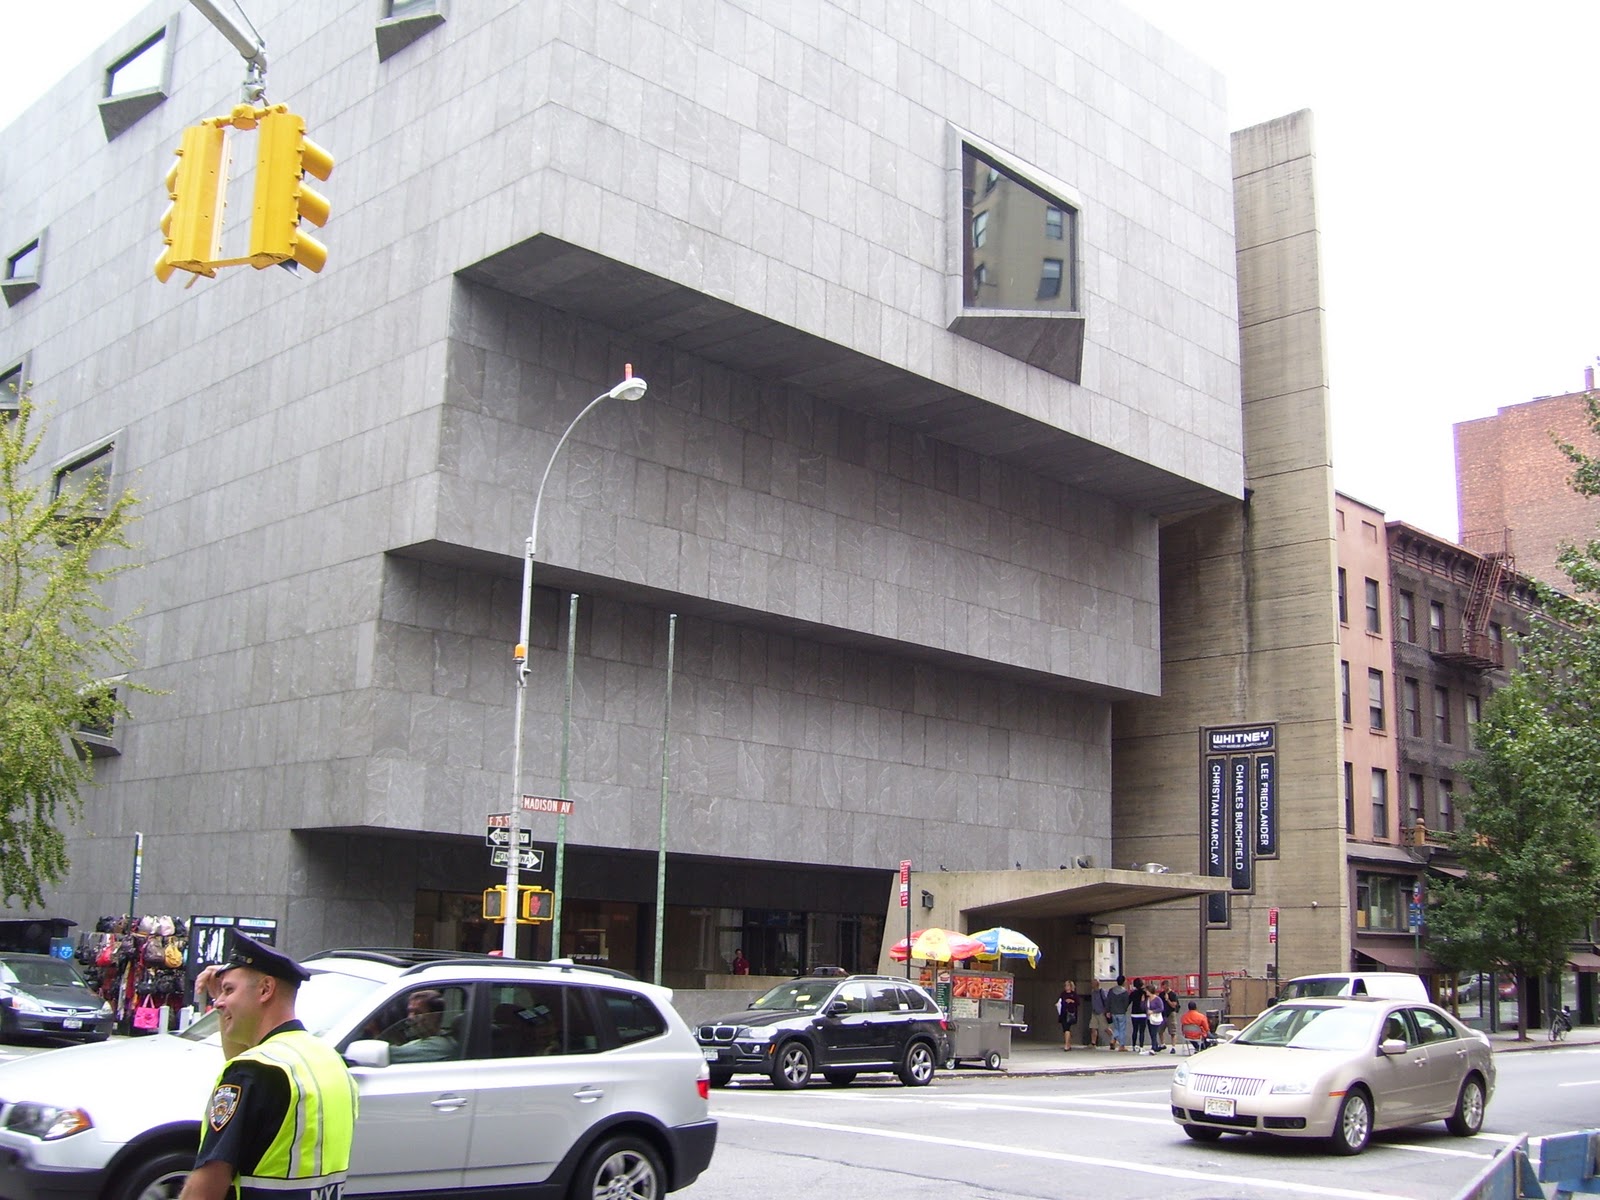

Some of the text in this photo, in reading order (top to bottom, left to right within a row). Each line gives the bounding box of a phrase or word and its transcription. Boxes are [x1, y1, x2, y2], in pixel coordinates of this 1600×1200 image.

[1212, 731, 1269, 744] WHITNEY
[524, 798, 571, 813] MADISON AV
[1210, 765, 1221, 865] CHRISTIAN MARCLAY
[1234, 764, 1244, 870] CHARLES BURCHFIELD
[1260, 763, 1269, 846] LEE FRIEDLANDER
[494, 832, 507, 841] ONE
